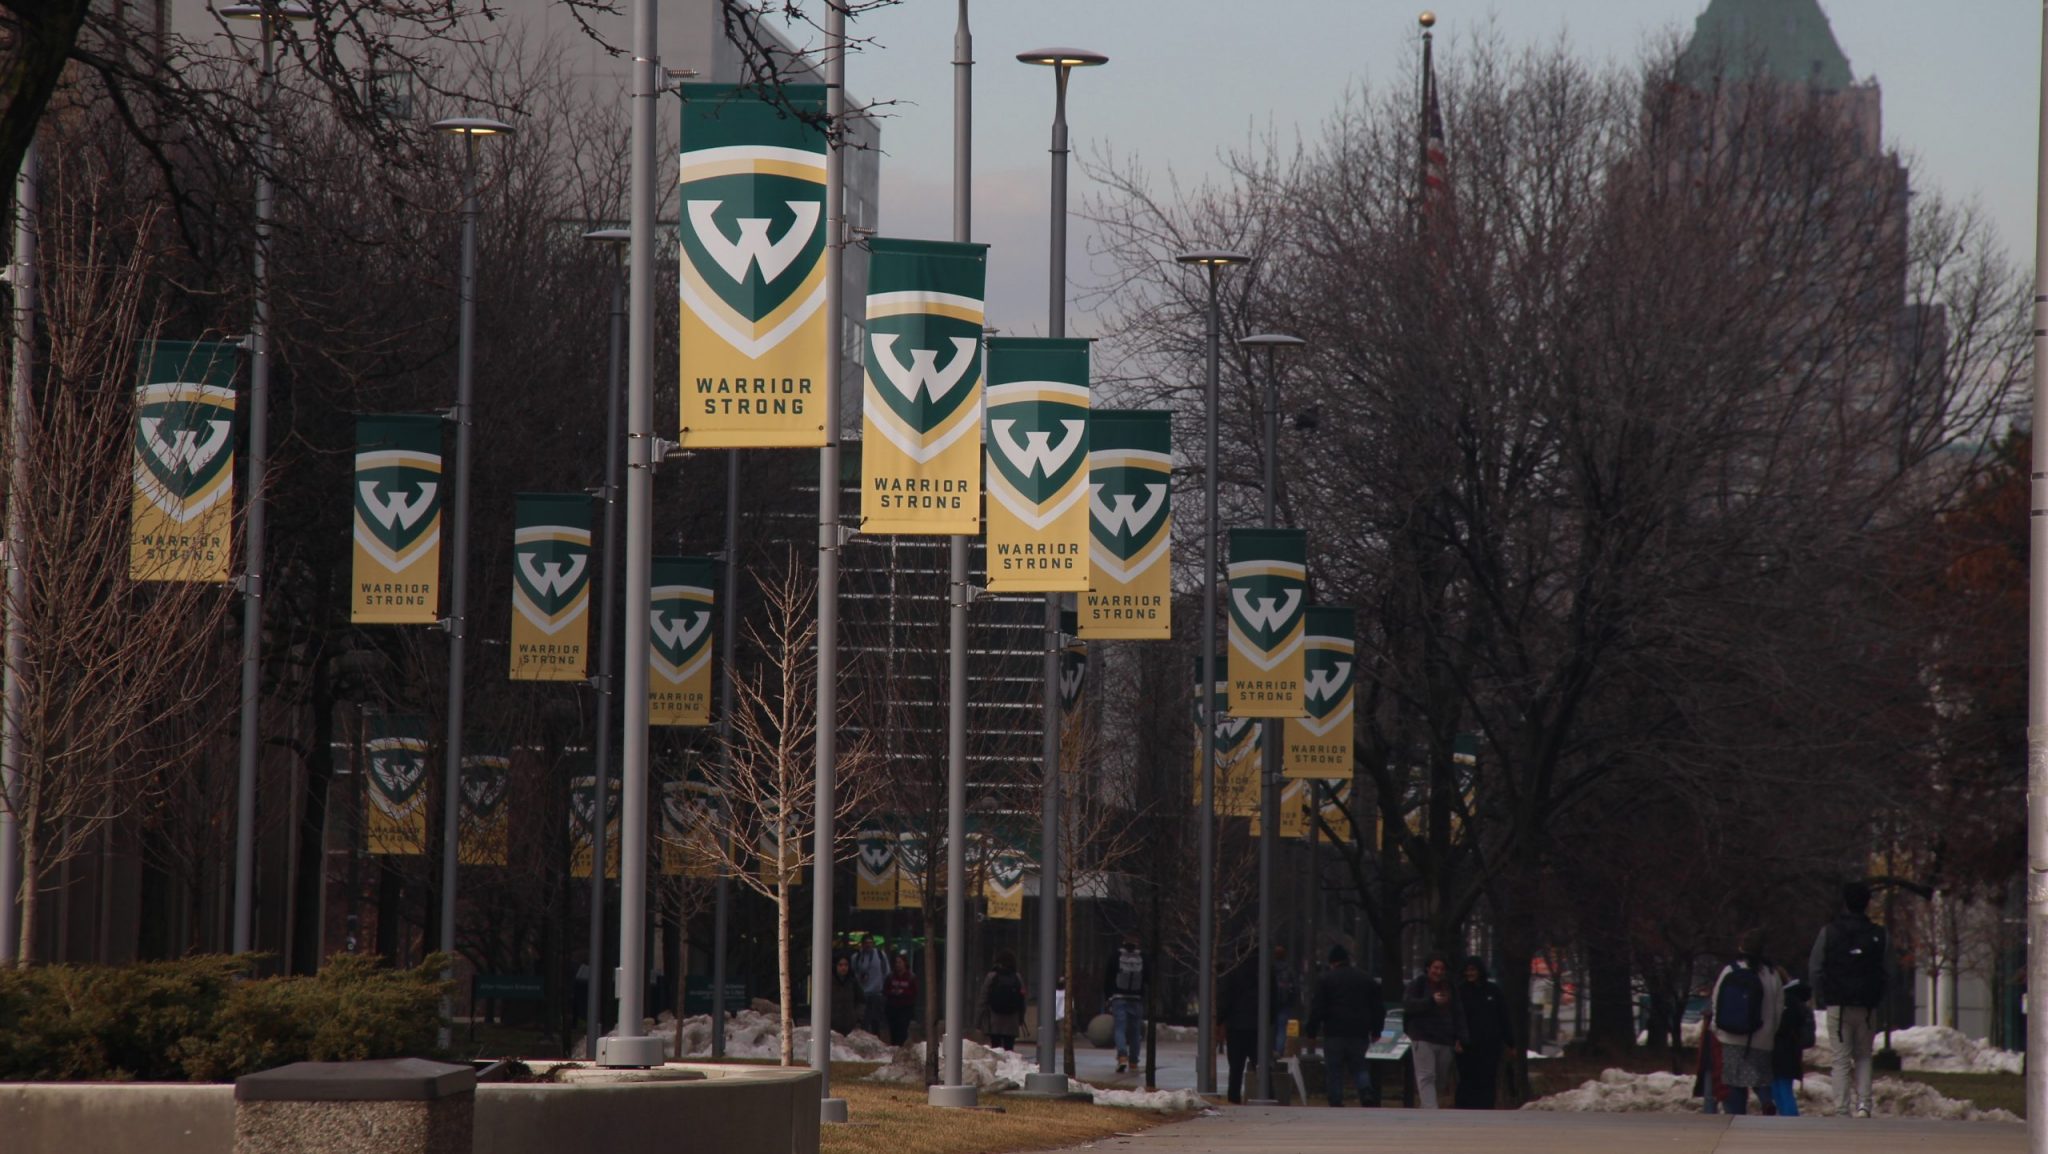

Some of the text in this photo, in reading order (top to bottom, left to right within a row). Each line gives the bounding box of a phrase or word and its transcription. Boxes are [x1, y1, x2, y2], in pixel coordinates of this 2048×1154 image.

[697, 378, 812, 394] WARRIOR
[705, 398, 804, 414] STRONG
[874, 477, 968, 493] WARRIOR
[880, 494, 962, 509] STRONG
[997, 543, 1079, 555] WARRIOR
[1003, 558, 1074, 569] STRONG
[361, 583, 430, 594] WARRIOR
[366, 595, 425, 605] STRONG
[1087, 595, 1162, 606] WARRIOR
[1092, 608, 1157, 619] STRONG
[519, 644, 580, 655] WARRIOR
[522, 655, 576, 665] STRONG
[1236, 680, 1298, 690] WARRIOR
[648, 692, 704, 702] WARRIOR
[1240, 691, 1293, 701] STRONG
[652, 702, 700, 711] STRONG
[1291, 744, 1347, 754] WARRIOR
[1294, 754, 1344, 764] STRONG
